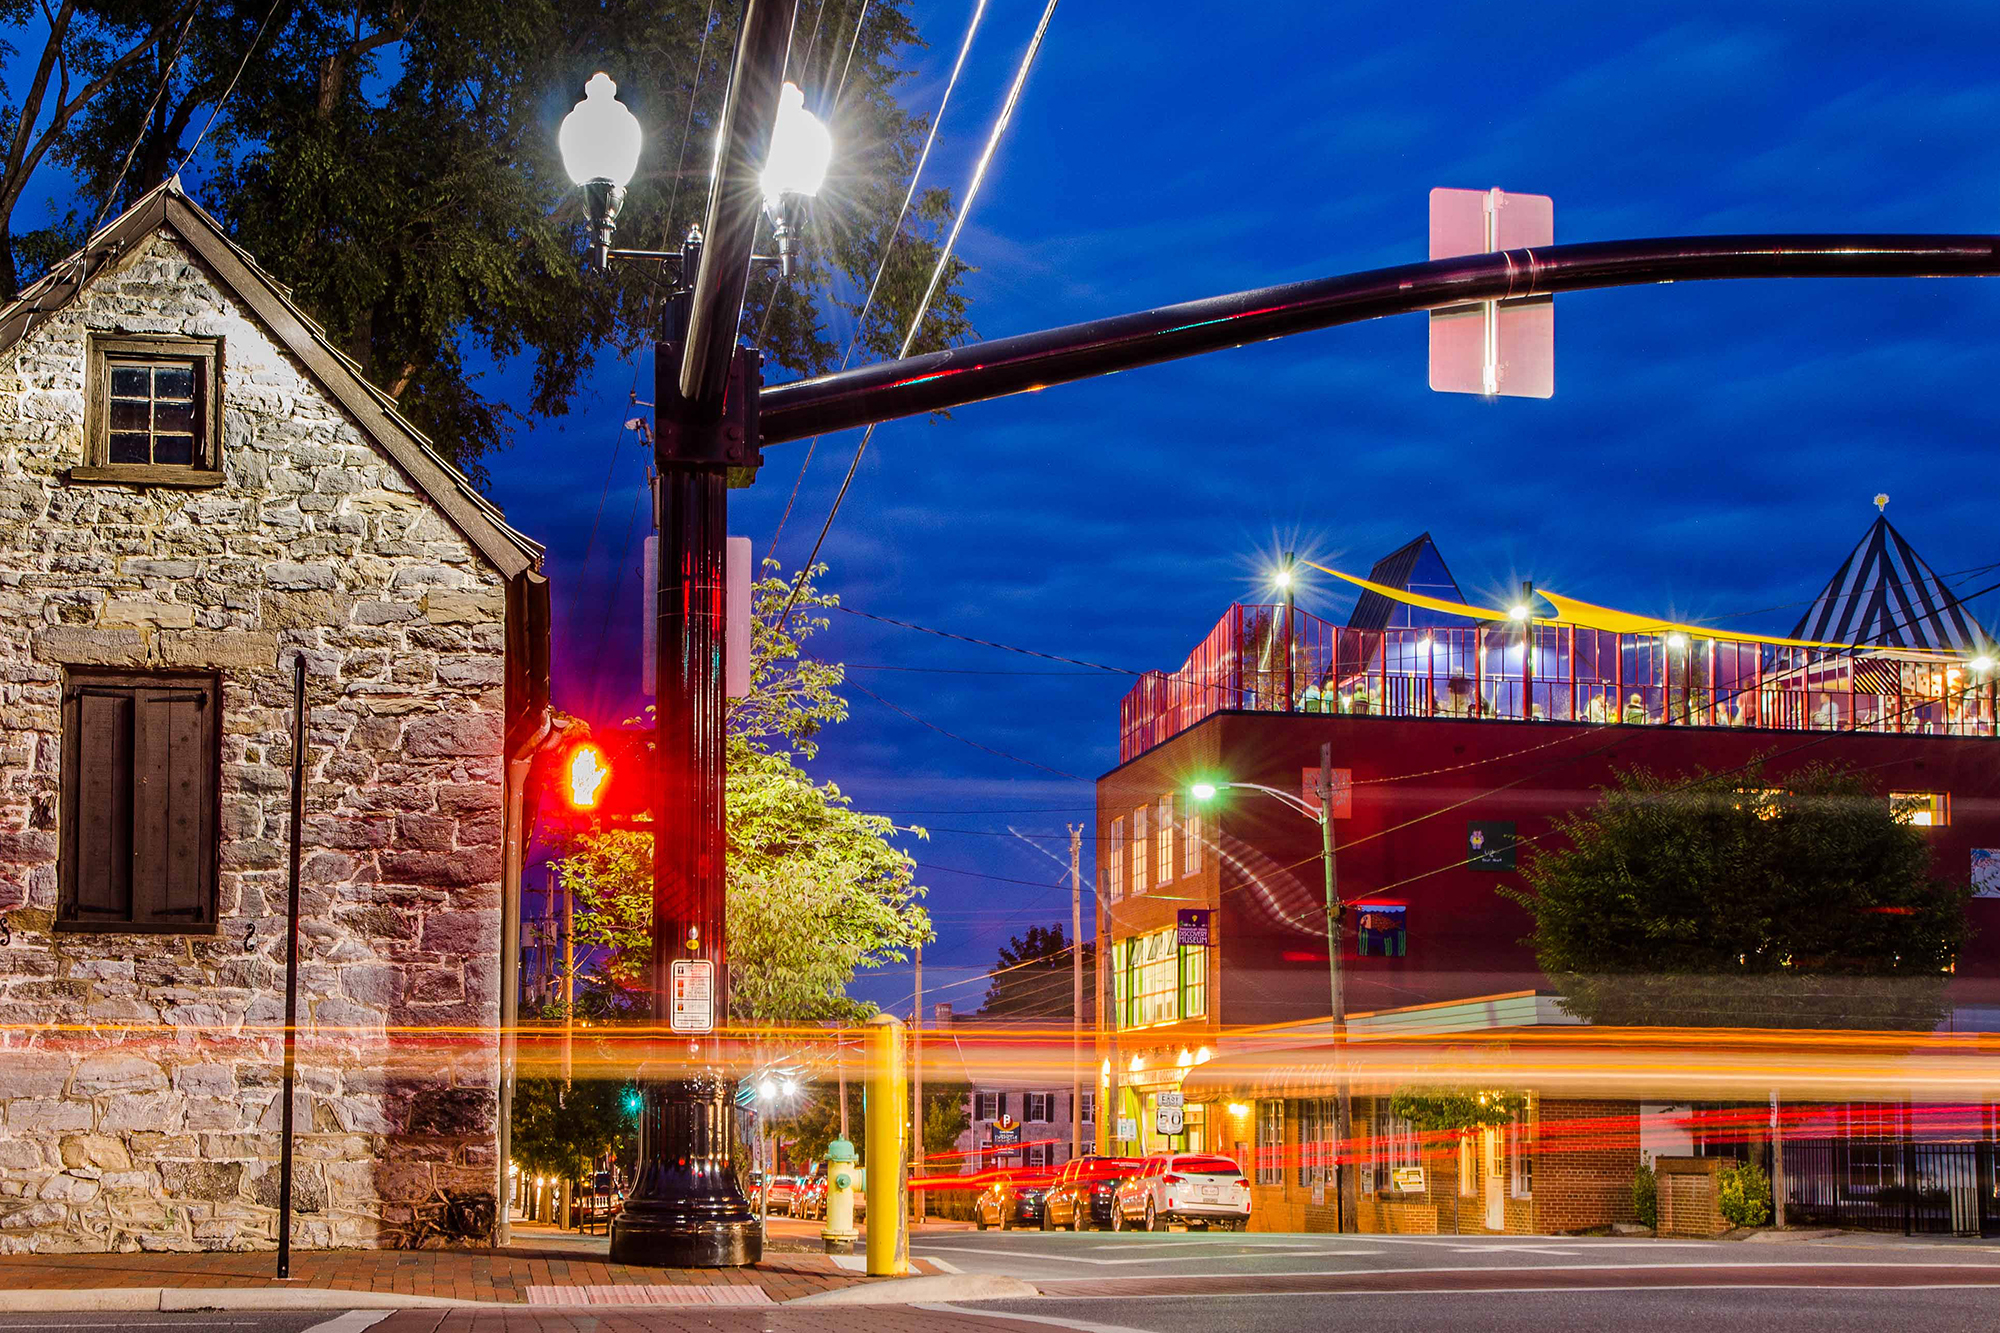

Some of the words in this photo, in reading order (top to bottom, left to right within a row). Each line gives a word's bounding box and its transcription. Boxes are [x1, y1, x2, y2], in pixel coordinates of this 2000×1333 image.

[1178, 936, 1207, 944] MUSEUM
[1161, 1095, 1179, 1105] EAST
[1003, 1114, 1011, 1128] P
[1160, 1111, 1181, 1129] 50
